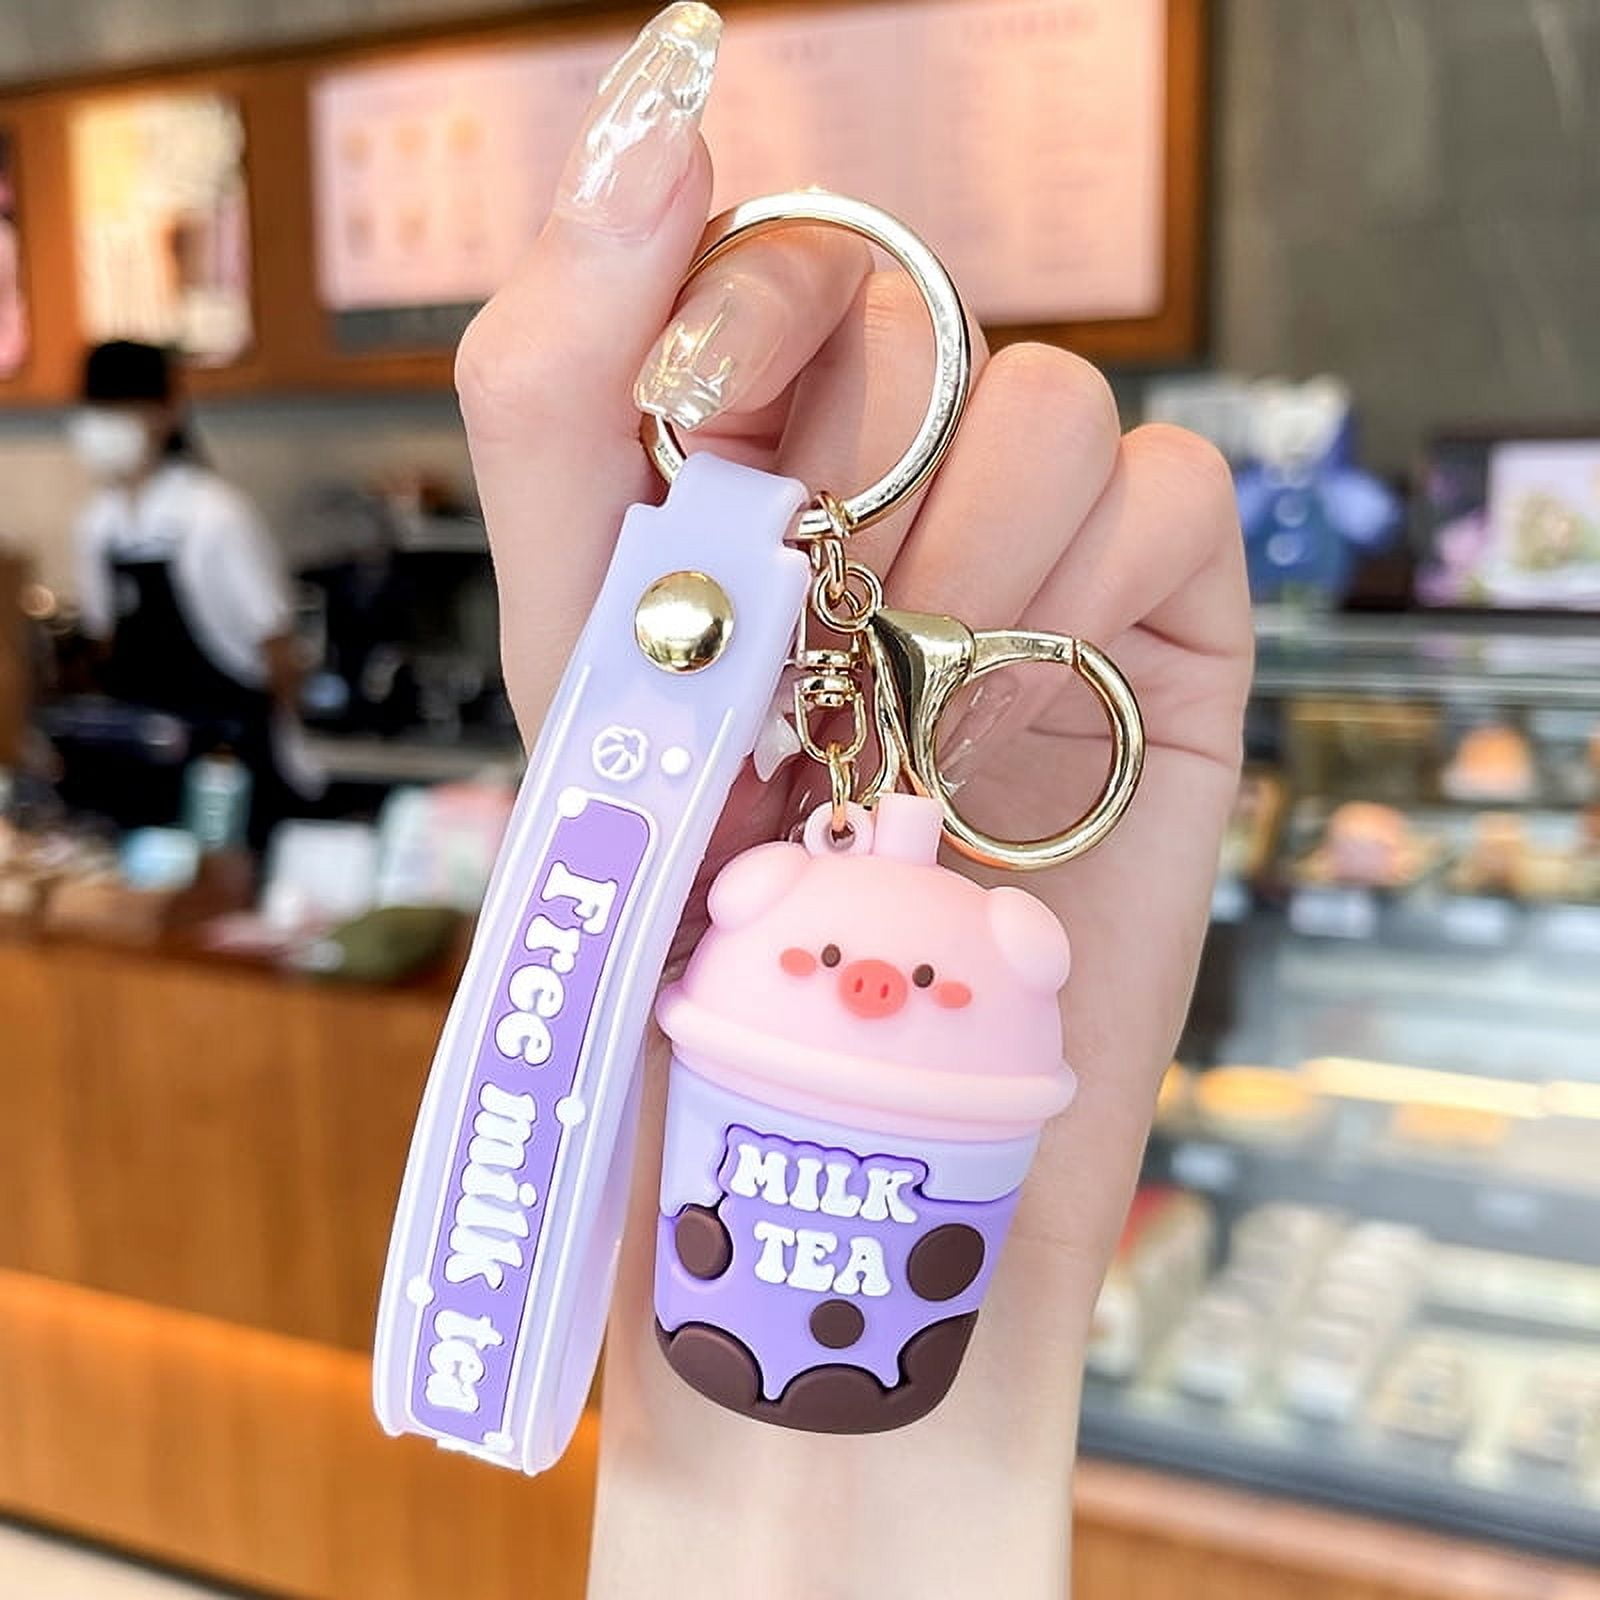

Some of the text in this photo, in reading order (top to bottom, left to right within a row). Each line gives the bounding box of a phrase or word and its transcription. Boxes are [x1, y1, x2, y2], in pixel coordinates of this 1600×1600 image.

[424, 860, 619, 1413] Free milk tea
[729, 1143, 918, 1223] MILK
[753, 1220, 892, 1297] TEA
